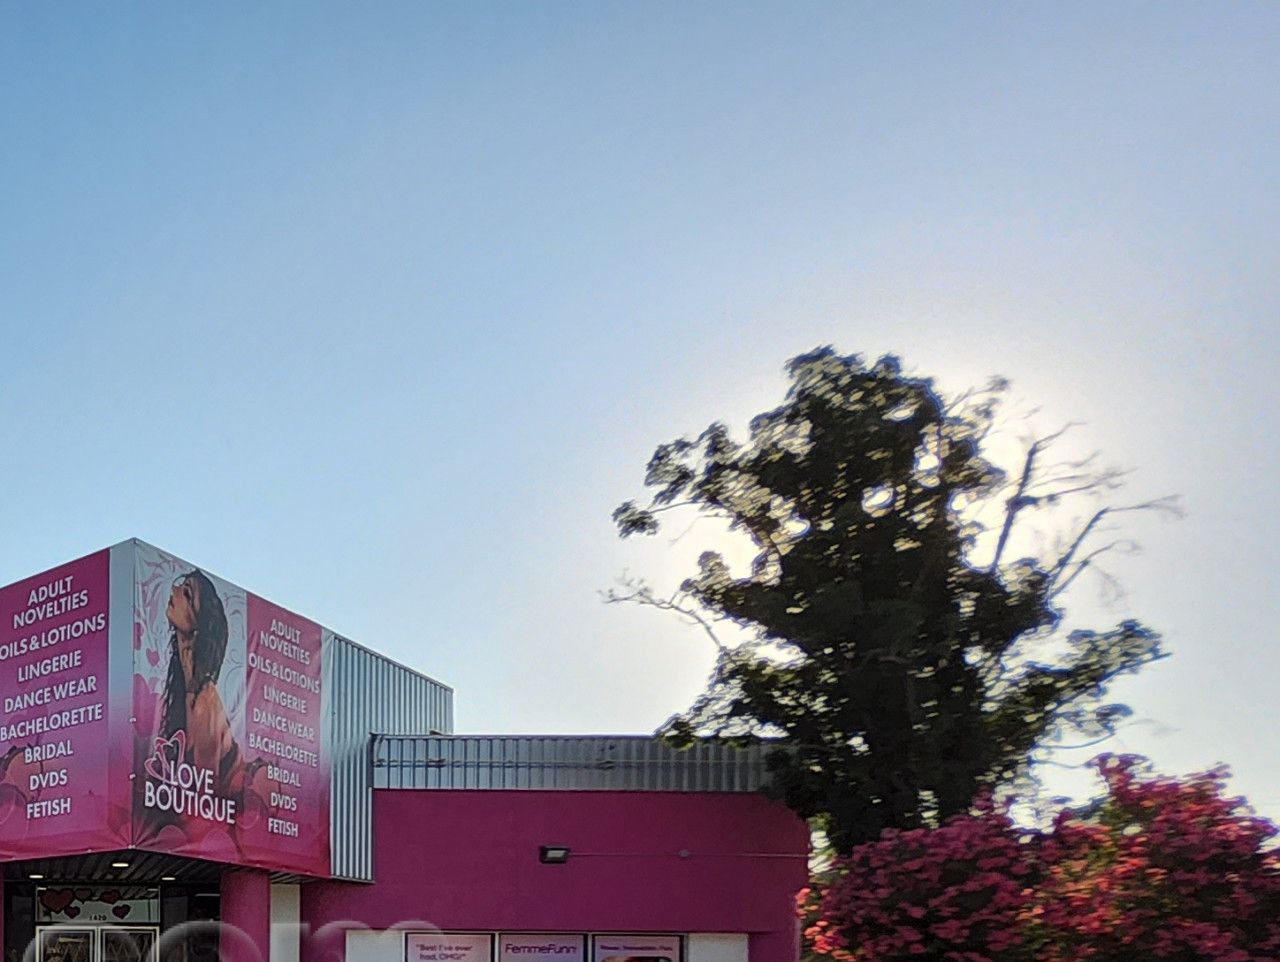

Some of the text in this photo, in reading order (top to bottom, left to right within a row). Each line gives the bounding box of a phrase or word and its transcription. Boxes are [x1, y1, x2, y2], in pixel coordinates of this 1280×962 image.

[28, 576, 74, 606] ADULT
[13, 590, 88, 629] NOVELTIES
[40, 613, 106, 649] LOTIONS
[270, 618, 301, 645] ADULT
[260, 630, 311, 665] NOVELTIES
[18, 650, 82, 682] LINGERIE
[248, 652, 272, 676] OILS
[280, 665, 320, 694] LOTIONS
[4, 675, 97, 713] DANCE WEAR
[263, 685, 307, 714] LINGERIE
[0, 703, 103, 742] BACHELORETTE
[24, 740, 74, 763] BRIDAL
[248, 733, 318, 768] BACHELORETTE
[29, 769, 68, 790] DVDS
[170, 760, 214, 795] LOVE
[267, 765, 302, 788] BRIDAL
[26, 797, 71, 819] FETISH
[144, 781, 236, 825] BOUTIQUE
[270, 792, 297, 812] DVDS
[268, 817, 299, 838] FETISH
